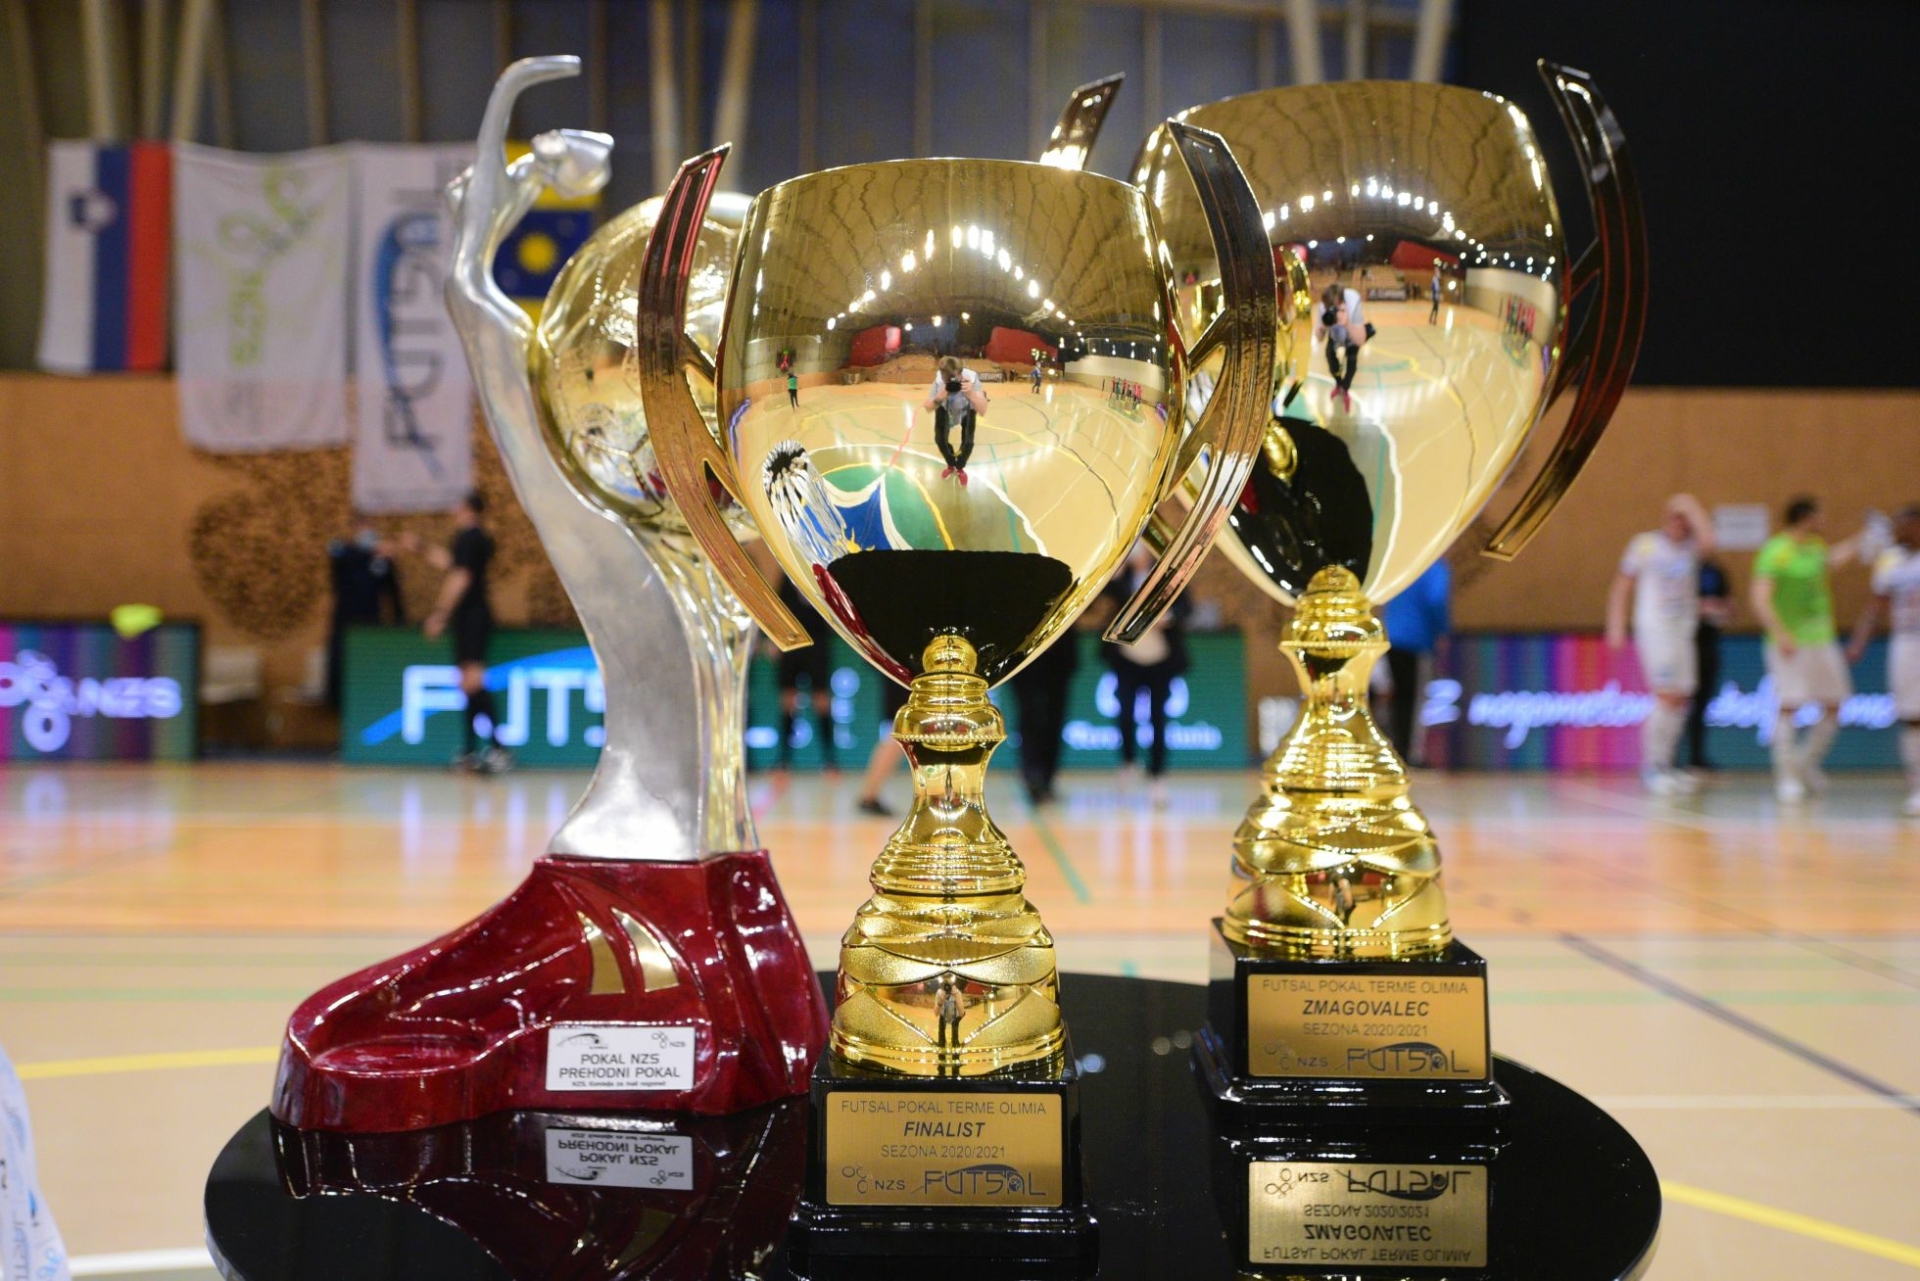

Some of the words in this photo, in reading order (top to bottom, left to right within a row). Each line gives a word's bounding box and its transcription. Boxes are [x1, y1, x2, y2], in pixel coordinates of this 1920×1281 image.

[1262, 979, 1314, 992] FUTSAL
[1319, 980, 1364, 993] POKAL
[1369, 980, 1417, 993] TERME
[1420, 981, 1468, 994] OLIMIA
[1302, 1000, 1430, 1017] ZMAGOVALEC
[1302, 1023, 1359, 1035] SEZONA
[1363, 1024, 1428, 1037] 2020/2021
[580, 1054, 625, 1065] POKAL
[630, 1053, 660, 1064] NZS
[1297, 1057, 1328, 1068] NZS
[1346, 1043, 1470, 1074] FUTSAL
[559, 1068, 630, 1078] PREHODNI
[635, 1067, 680, 1077] POKAL
[841, 1100, 893, 1113] FUTSAL
[897, 1101, 943, 1114] POKAL
[948, 1101, 995, 1114] TERME
[999, 1102, 1046, 1115] OLIMIA
[903, 1121, 986, 1138] FINALIST
[881, 1145, 938, 1158] SEZONA
[941, 1145, 1006, 1159] 2020/2021
[874, 1179, 906, 1191] NZS
[922, 1164, 1046, 1196] FUTSAL
